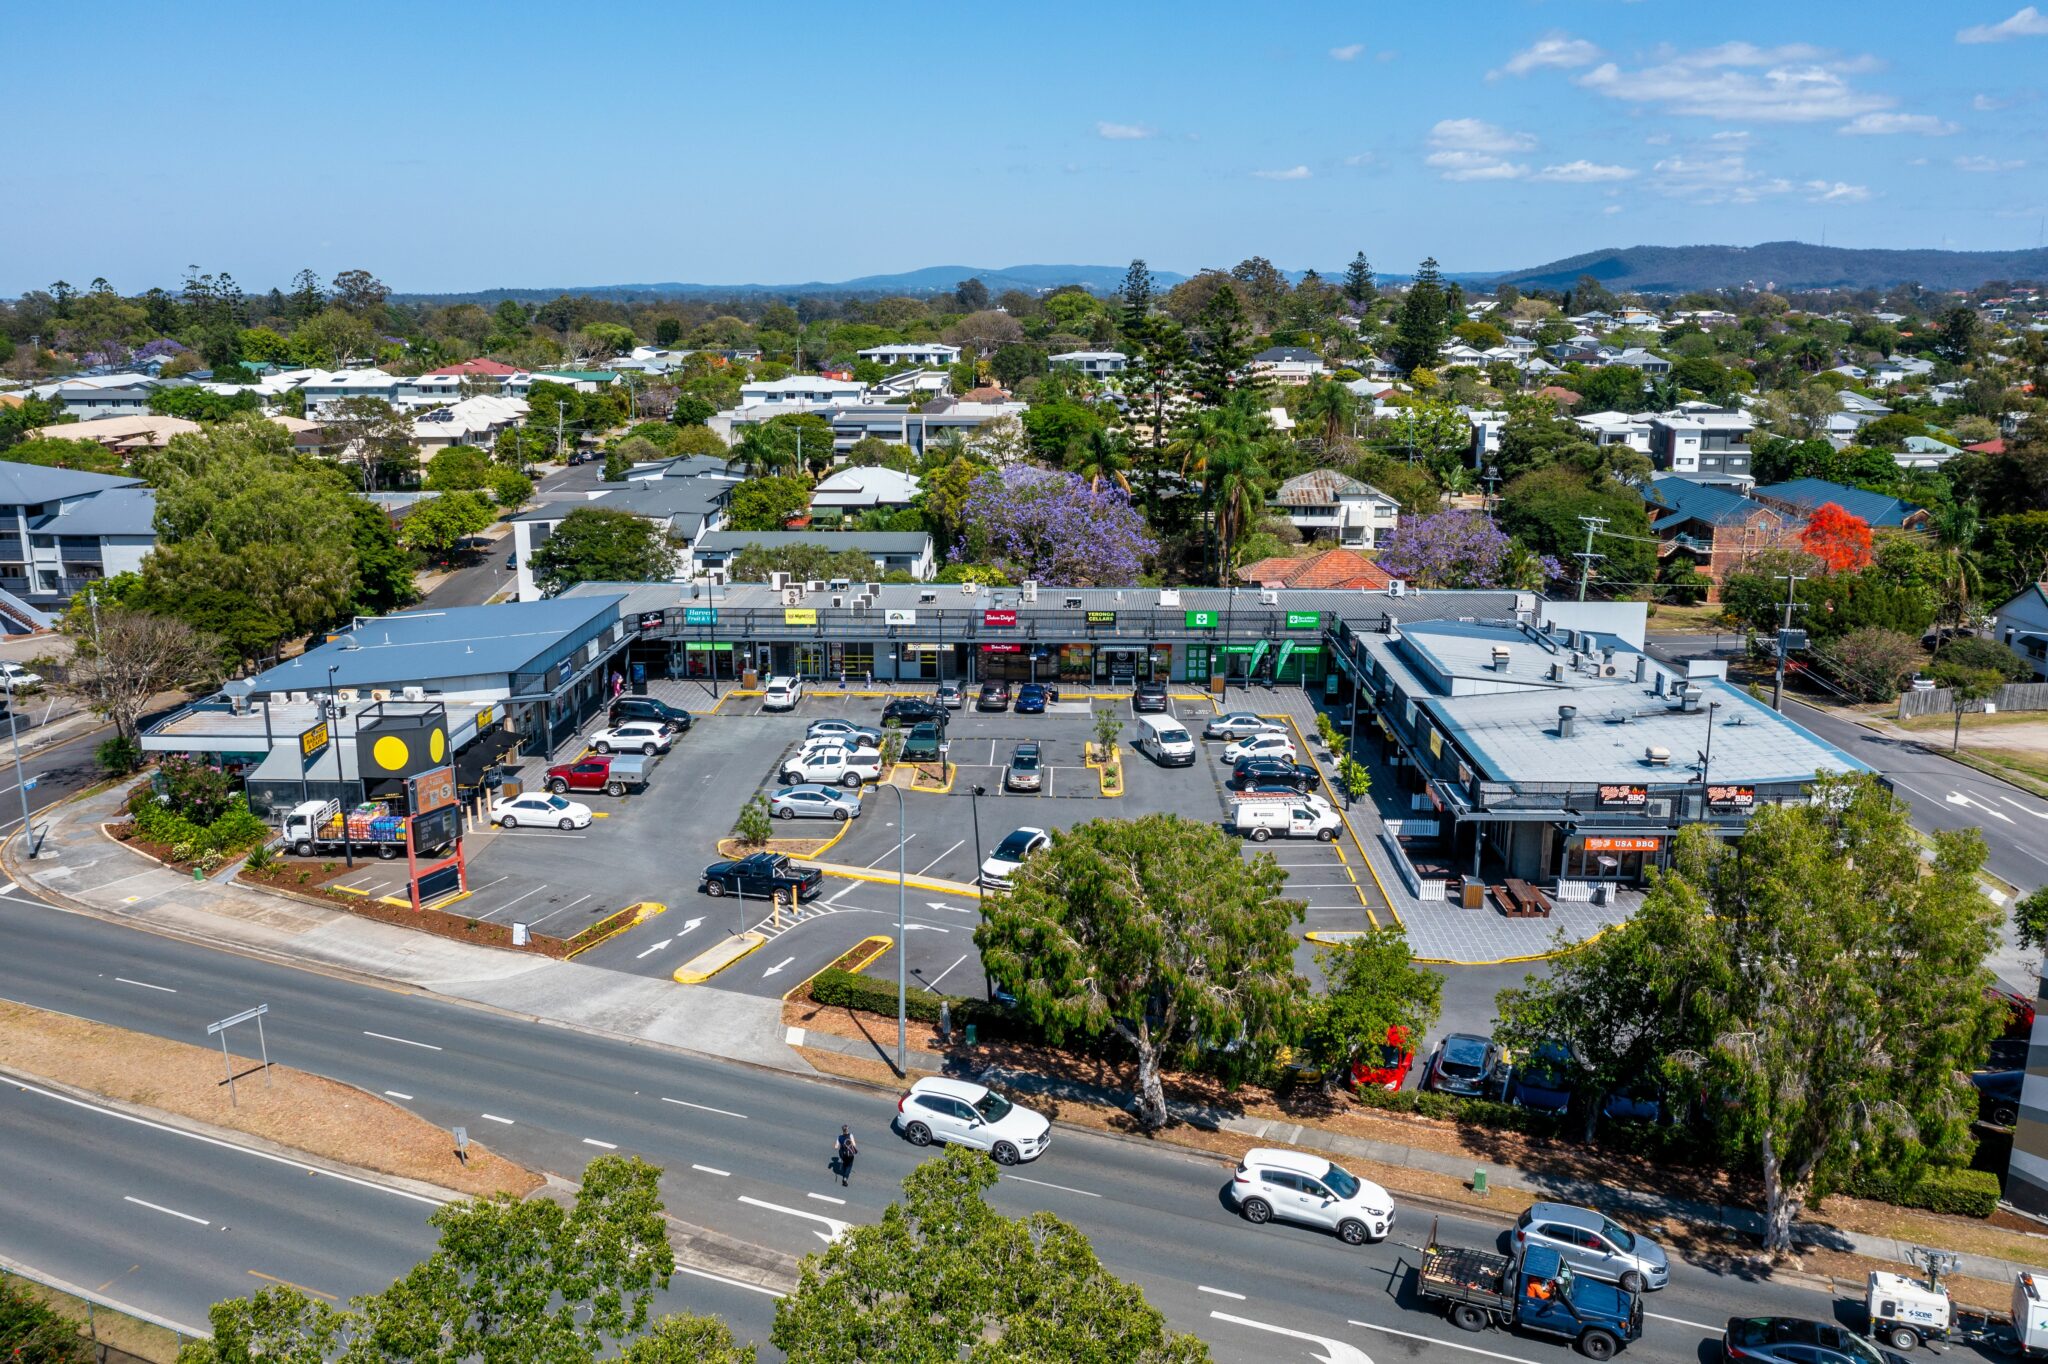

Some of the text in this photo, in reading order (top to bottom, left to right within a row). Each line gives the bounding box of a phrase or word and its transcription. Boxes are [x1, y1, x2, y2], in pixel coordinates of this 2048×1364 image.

[1627, 794, 1646, 802] BBQ
[1735, 795, 1753, 803] BBQ
[1636, 840, 1654, 848] BBQ
